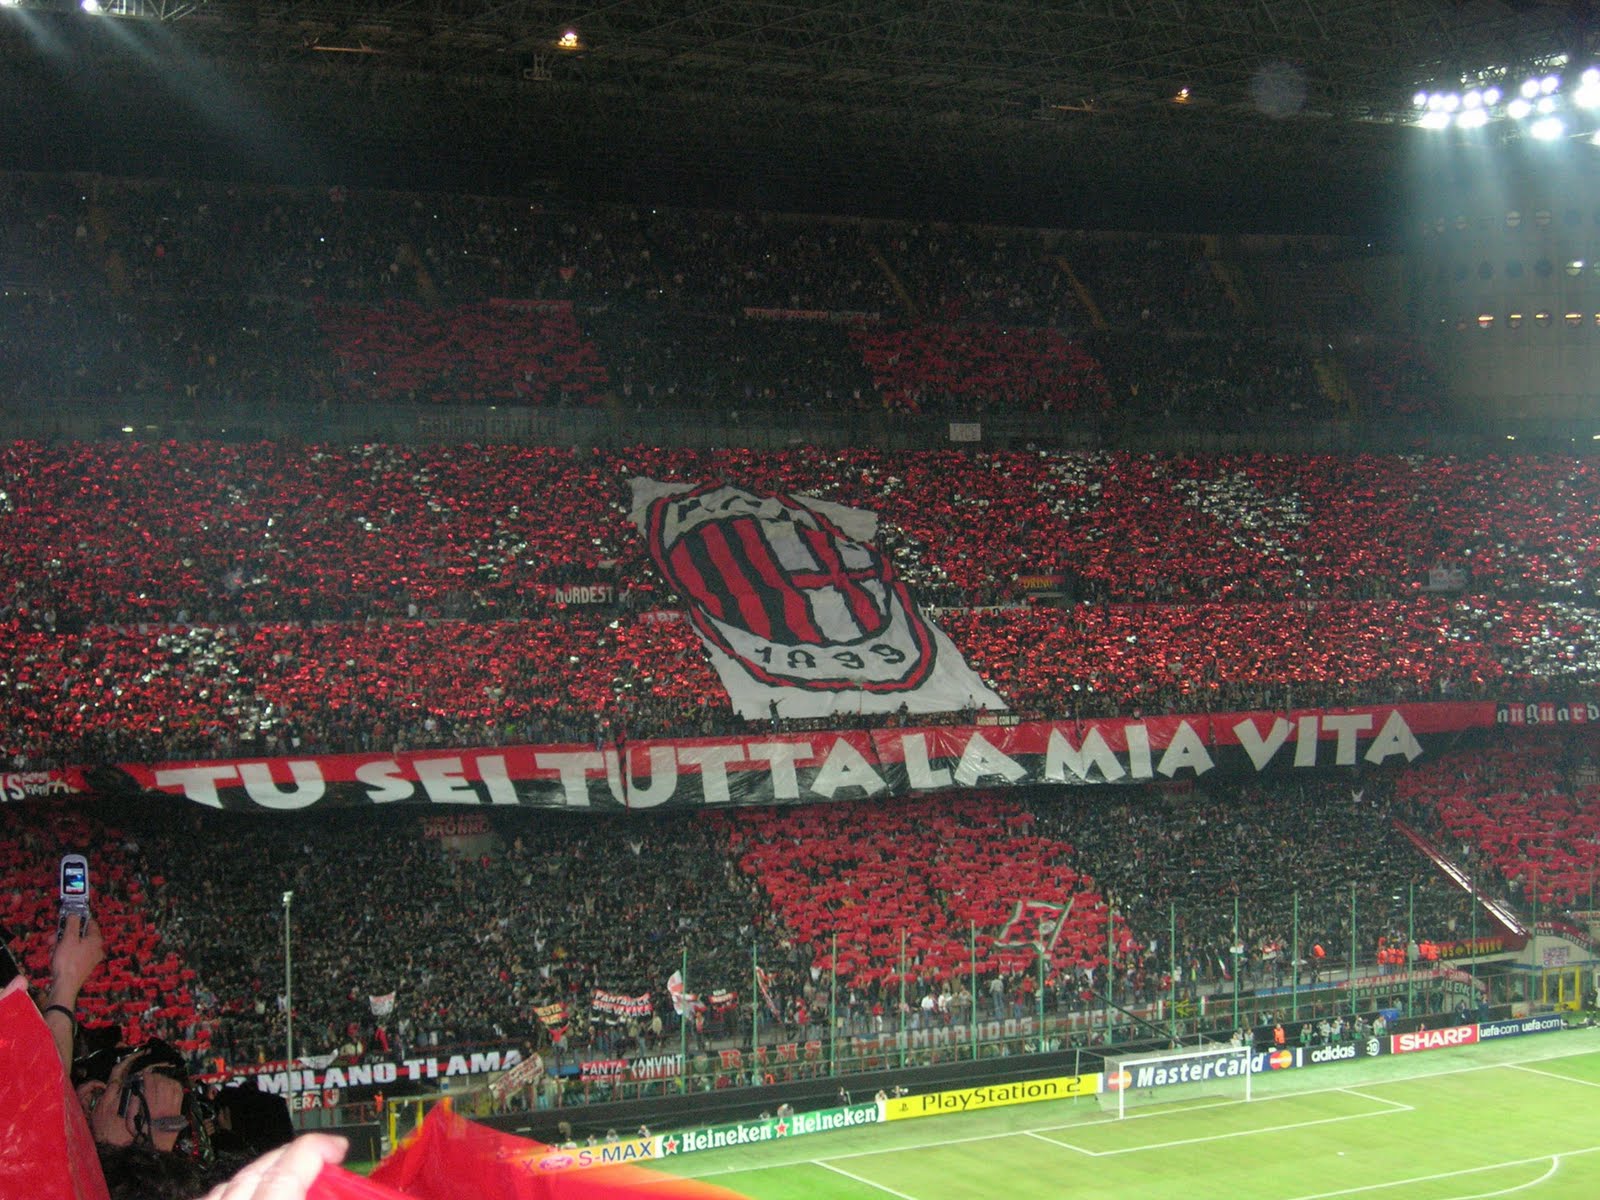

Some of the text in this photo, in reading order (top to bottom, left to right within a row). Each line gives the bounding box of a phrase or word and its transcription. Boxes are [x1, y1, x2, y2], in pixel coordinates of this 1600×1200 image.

[754, 645, 906, 669] 1899
[155, 709, 1424, 810] TU SEI TUTTA LA MIA VITA
[1311, 1044, 1356, 1063] adidas
[1400, 1027, 1472, 1051] SHARP
[257, 1062, 396, 1094] MILANO
[404, 1057, 438, 1080] TI
[446, 1050, 523, 1076] AMA
[1137, 1052, 1263, 1088] MasterCard
[922, 1076, 1082, 1112] PlayStation 2
[682, 1105, 877, 1152] Heineken Heineken
[577, 1140, 652, 1169] S-MAX
